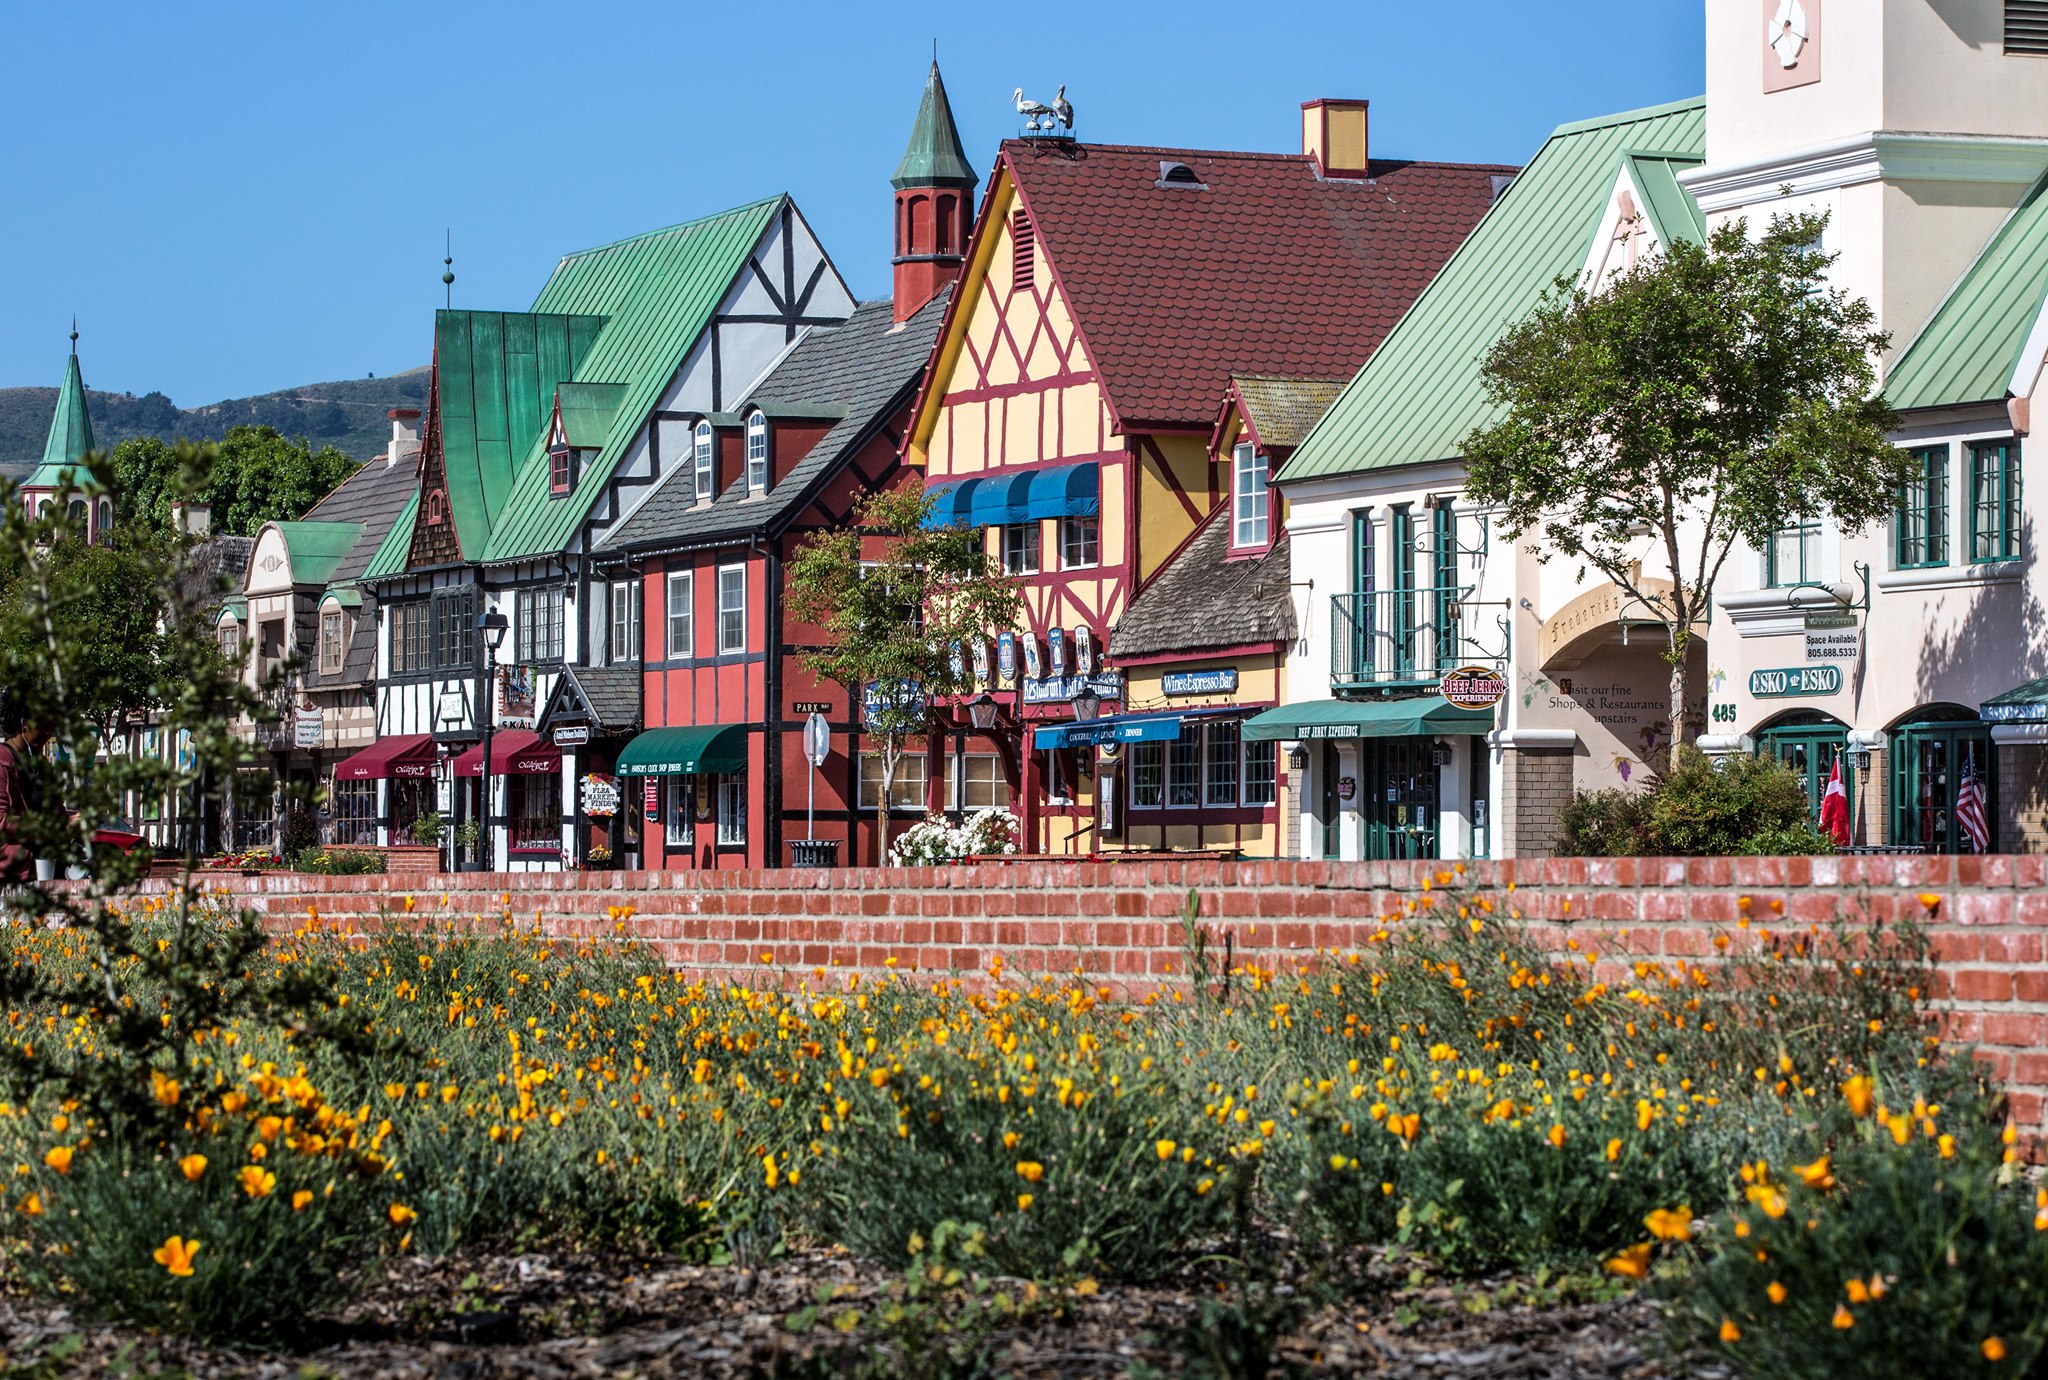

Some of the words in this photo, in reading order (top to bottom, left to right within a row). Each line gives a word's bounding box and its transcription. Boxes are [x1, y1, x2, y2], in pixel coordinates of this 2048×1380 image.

[1806, 635, 1827, 647] Space
[1827, 634, 1857, 644] Available
[1807, 647, 1857, 658] 805.688.5333
[1219, 672, 1233, 688] Bar
[1443, 679, 1470, 694] BEEF
[1470, 678, 1505, 694] JERKY
[1752, 671, 1787, 694] ESKO
[1801, 668, 1838, 691] ESKO
[1591, 687, 1609, 695] our
[1611, 683, 1632, 697] fine
[1451, 694, 1497, 702] EXPERIENCE
[1548, 696, 1582, 710] Shops
[1585, 698, 1595, 709] &
[1600, 697, 1665, 710] Restaurants
[796, 703, 818, 712] PARK
[1712, 703, 1736, 722] 485
[502, 719, 533, 729] SKÅL
[1594, 713, 1638, 724] upstairs
[1125, 728, 1142, 737] DINNER
[1298, 726, 1311, 738] BEEF
[1311, 725, 1328, 738] JERKY
[1328, 724, 1358, 737] EXPERIENCE
[658, 763, 668, 772] SHOP
